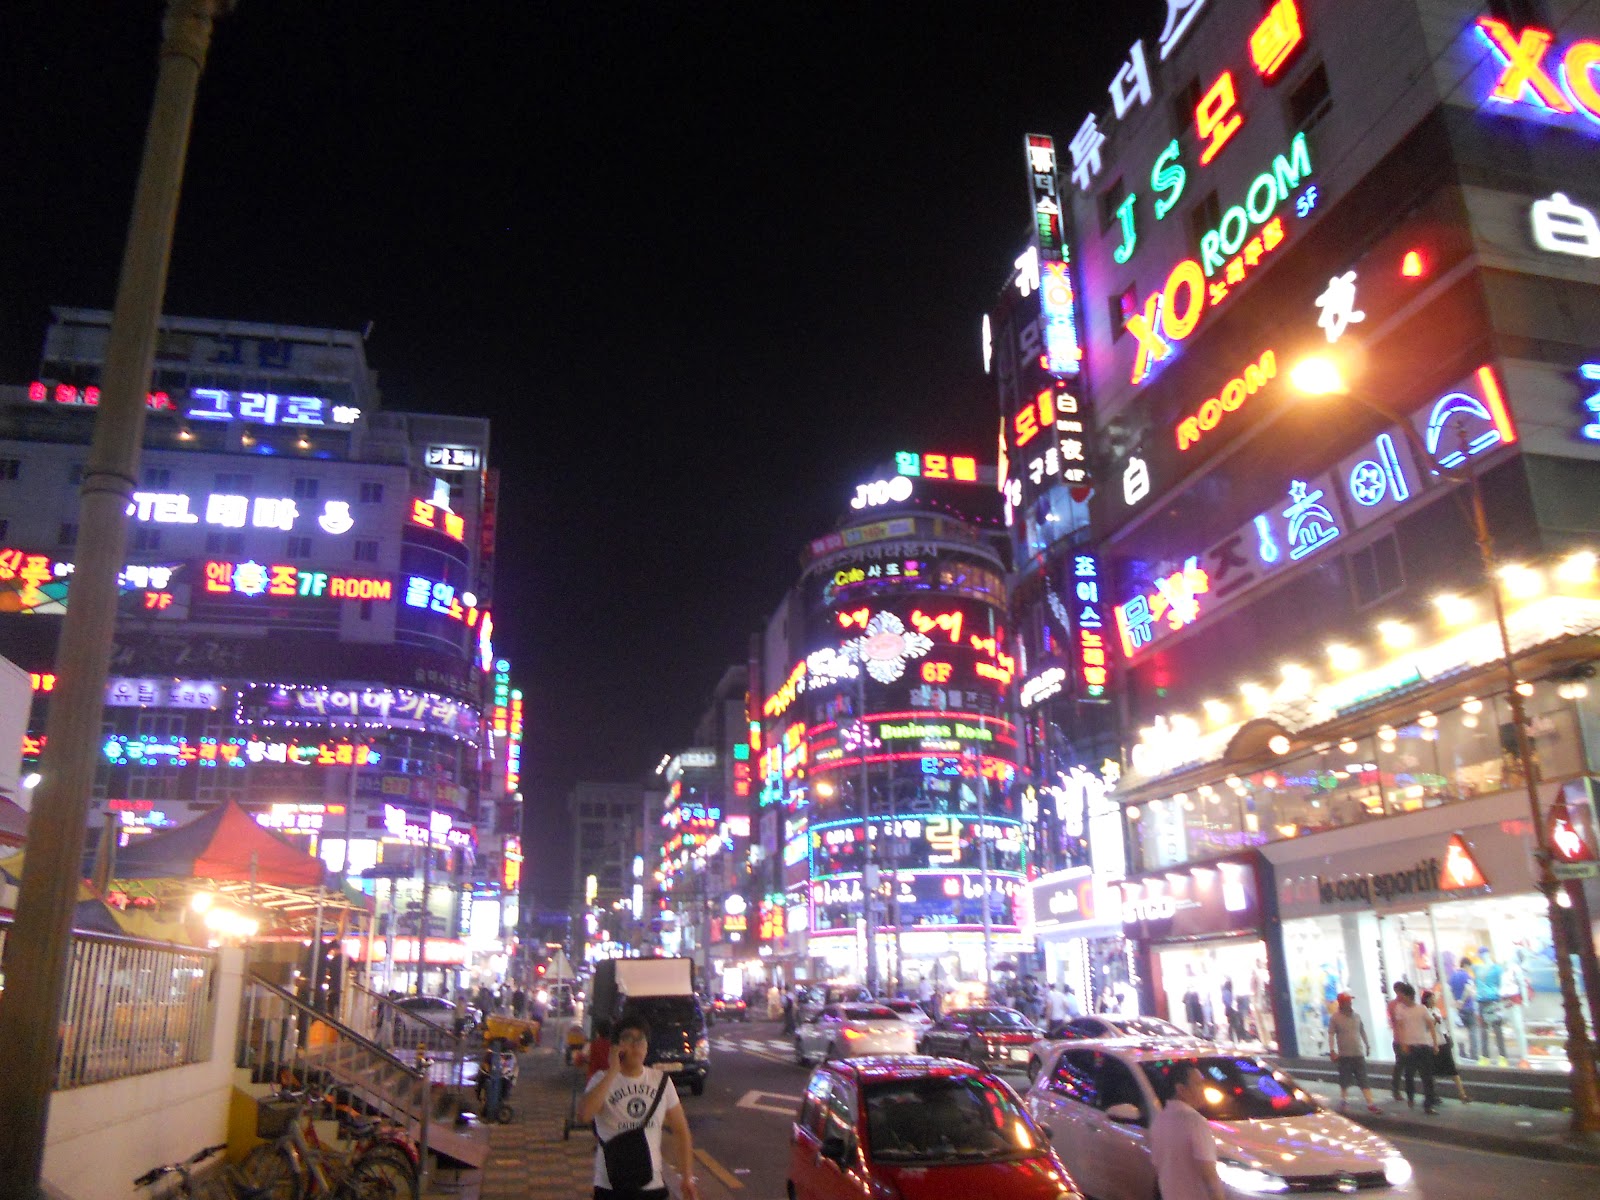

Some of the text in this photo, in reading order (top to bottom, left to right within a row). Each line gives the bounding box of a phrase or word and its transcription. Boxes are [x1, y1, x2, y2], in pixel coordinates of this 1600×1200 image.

[1200, 131, 1312, 278] ROOM
[1125, 258, 1207, 386] XO
[1175, 348, 1278, 451] ROOM
[1122, 456, 1151, 507] 白
[297, 572, 328, 597] 7F
[331, 577, 392, 600] ROOM
[297, 690, 457, 725] 나이아가라
[880, 722, 952, 740] Business
[608, 1084, 657, 1106] HOLLISTE
